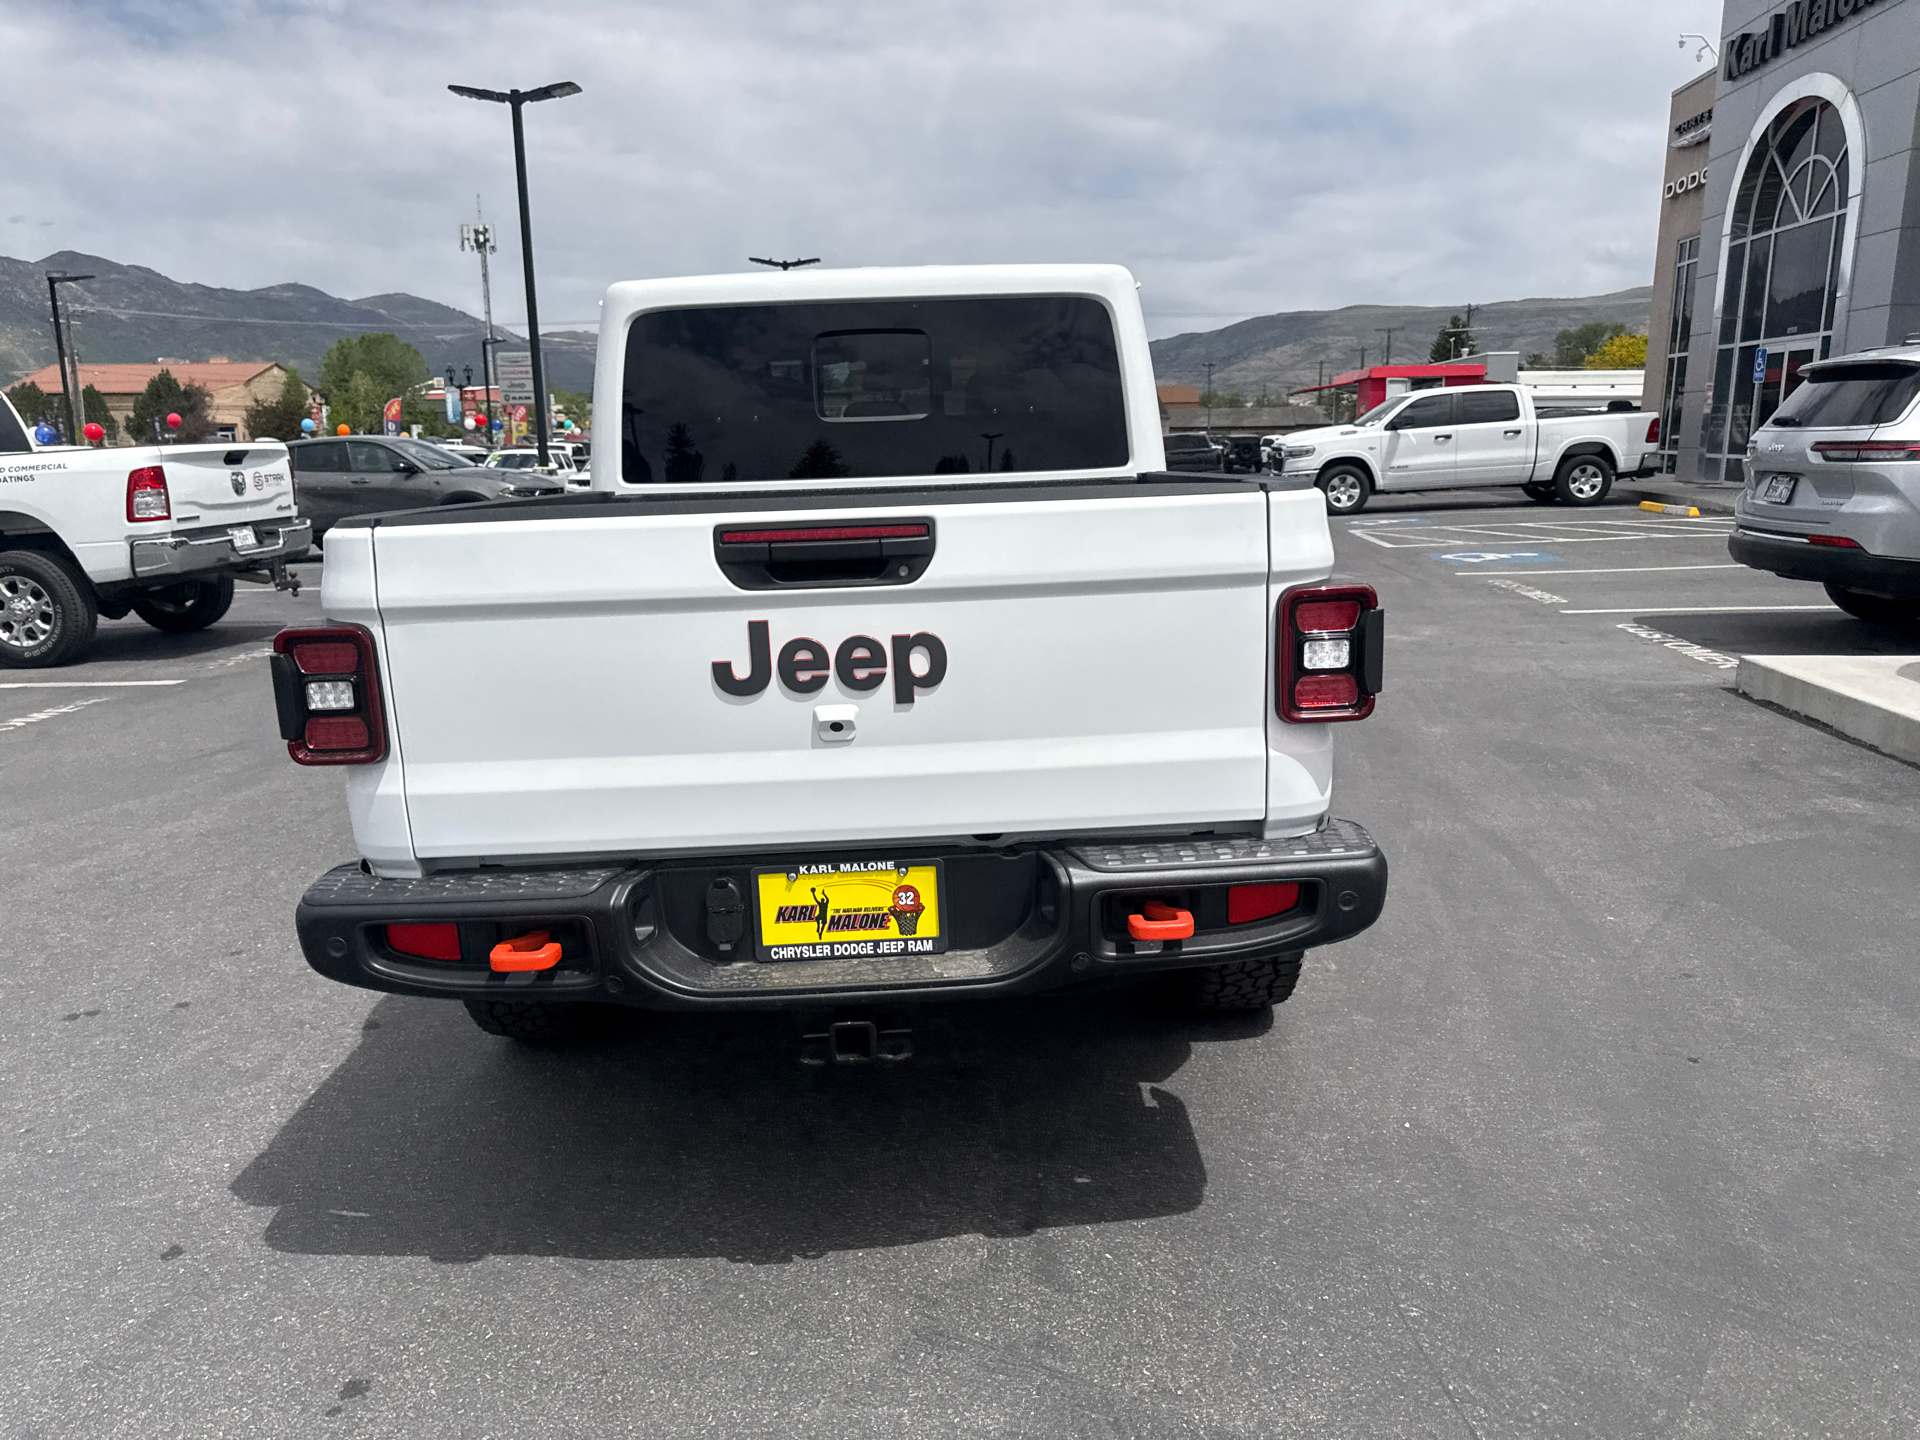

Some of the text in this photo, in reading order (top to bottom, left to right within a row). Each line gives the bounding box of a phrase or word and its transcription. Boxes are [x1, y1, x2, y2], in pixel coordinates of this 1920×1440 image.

[1723, 13, 1784, 81] Karl
[8, 463, 68, 473] COMMERCIAL
[0, 474, 35, 484] ATINGS
[263, 472, 286, 483] STARK
[711, 620, 947, 704] Jeep
[798, 861, 896, 875] KARL MALONE
[897, 891, 914, 905] 32
[774, 904, 818, 924] KARL
[826, 912, 891, 933] MALONE
[770, 939, 933, 959] CHRYSLER DODGE JEEP RAM
